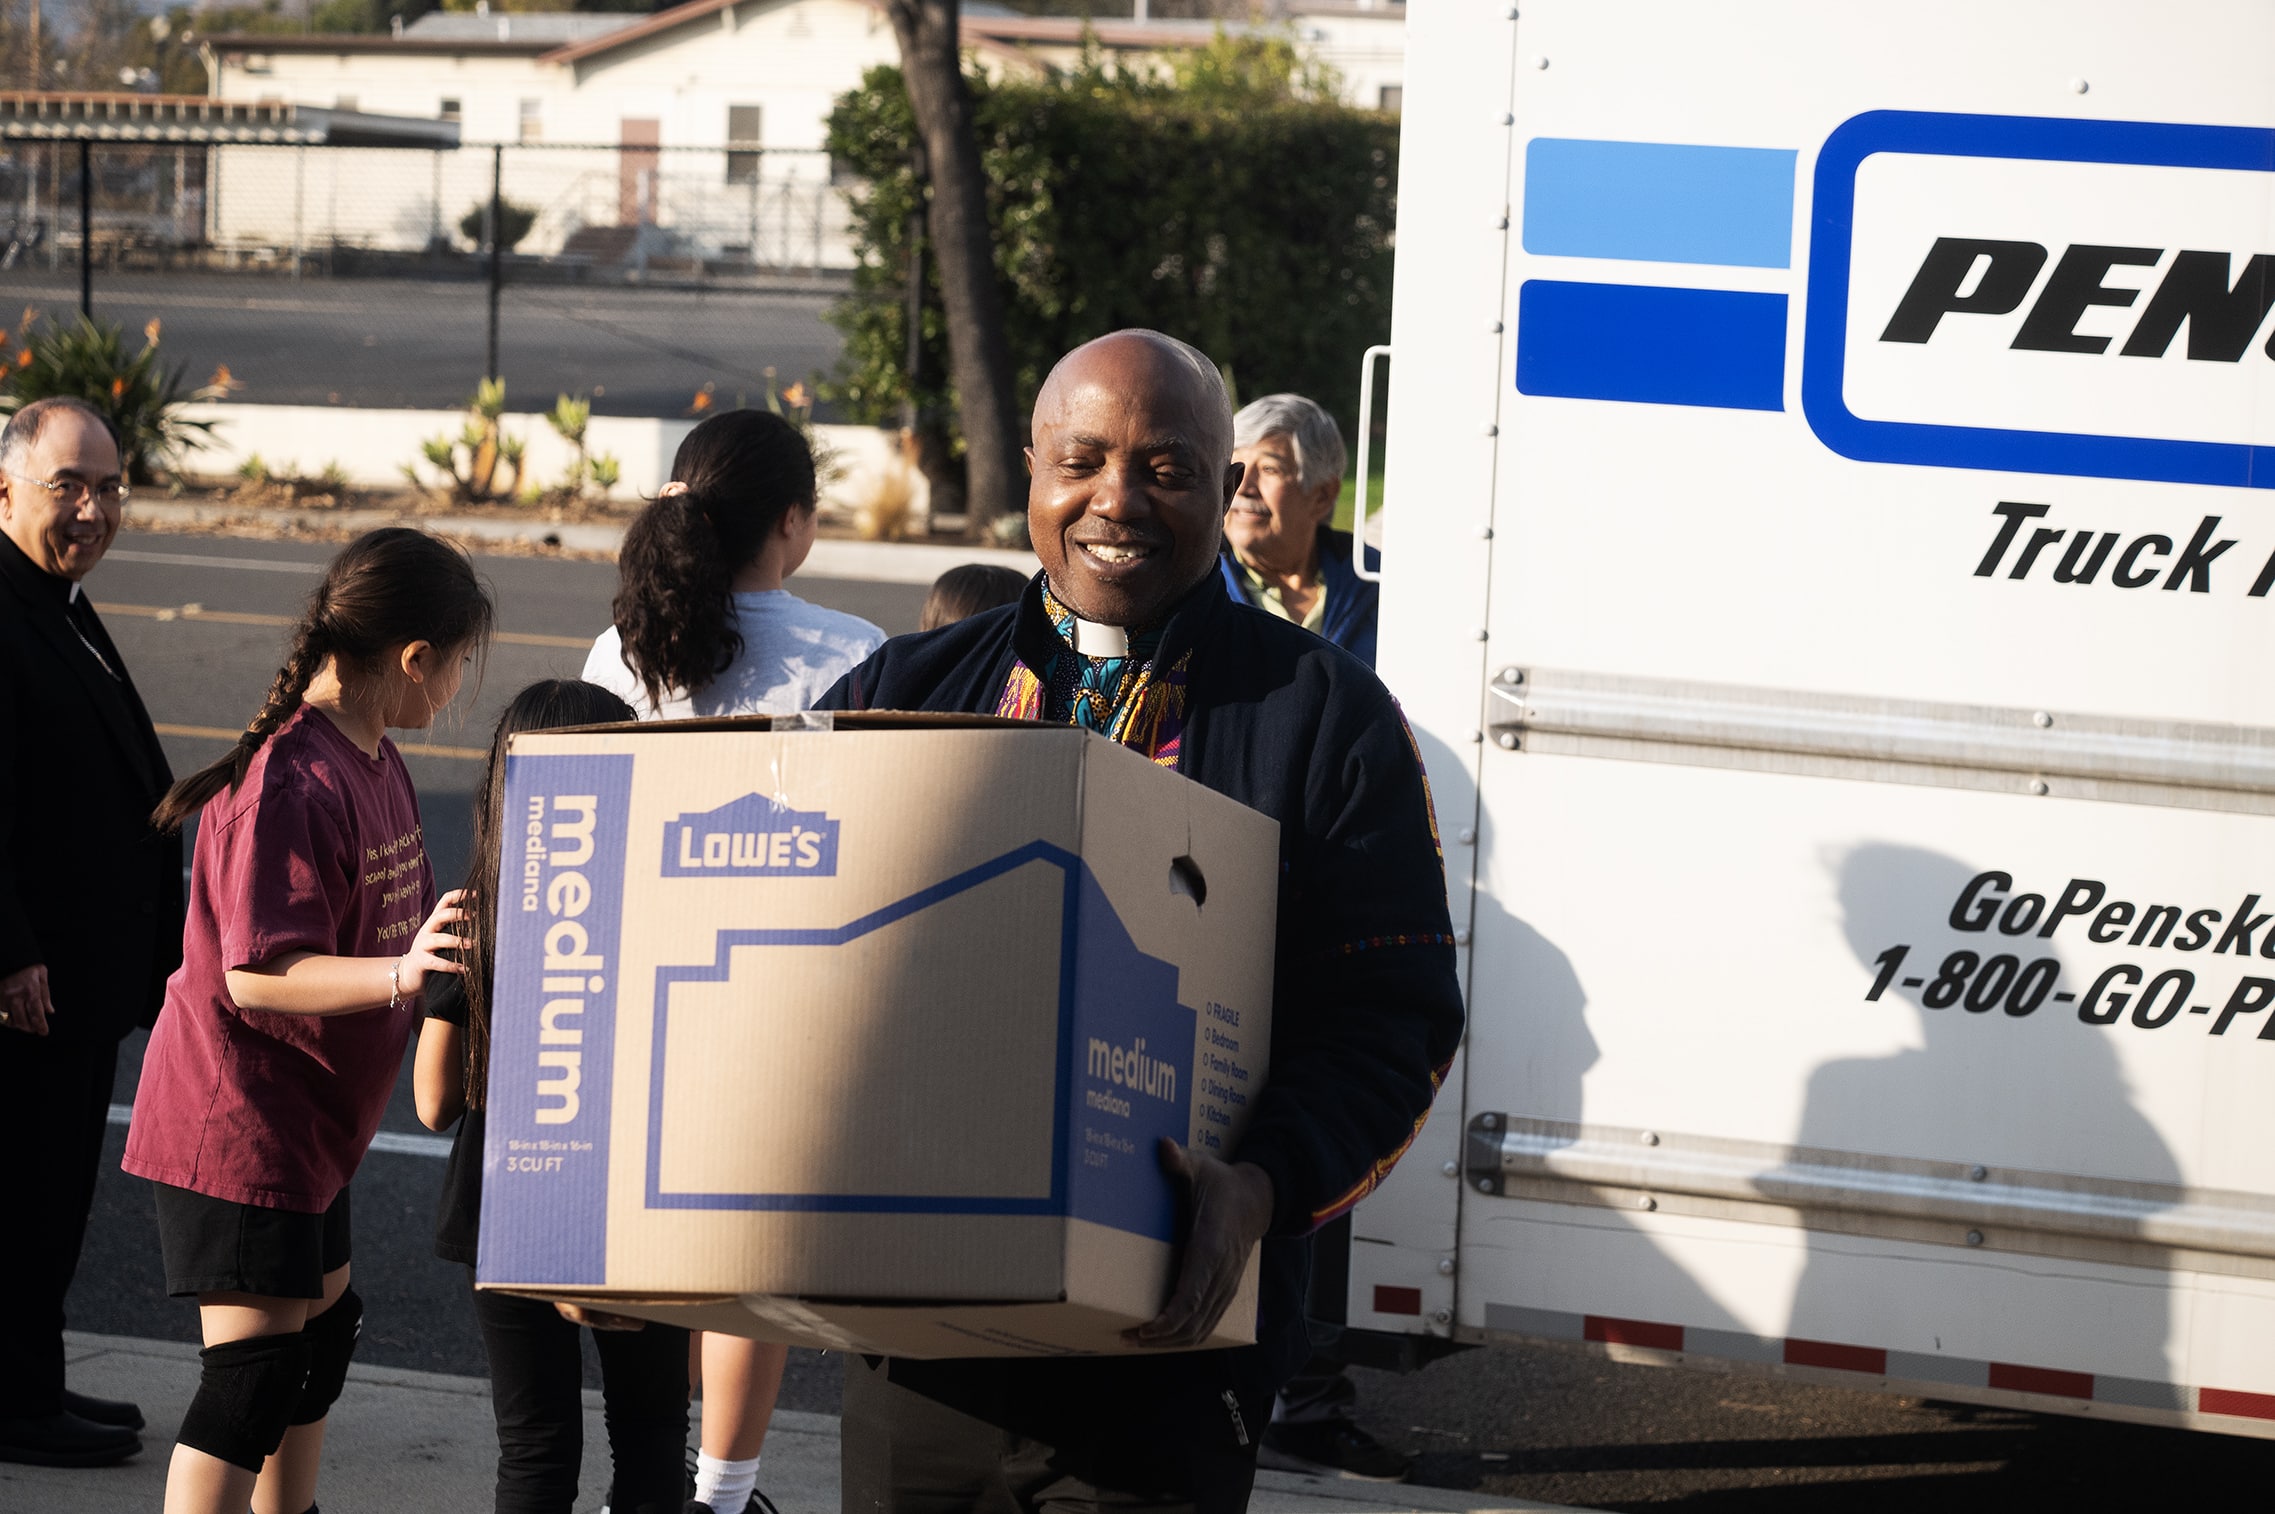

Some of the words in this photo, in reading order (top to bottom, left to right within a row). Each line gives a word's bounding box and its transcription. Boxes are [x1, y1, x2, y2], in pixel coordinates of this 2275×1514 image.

[1879, 237, 2275, 362] PEN
[1973, 501, 2239, 593] Truck
[522, 796, 546, 912] mediana
[679, 825, 822, 868] LOWE'S
[535, 795, 605, 1124] medium
[1212, 1003, 1240, 1028] FRAGILE
[1211, 1028, 1240, 1053] Bedroom
[1087, 1037, 1177, 1103] medium
[1210, 1053, 1230, 1079] Family
[1231, 1061, 1249, 1081] Room
[1086, 1089, 1130, 1118] mediana
[1206, 1104, 1232, 1127] Kitchen
[506, 1157, 518, 1172] 3
[519, 1157, 542, 1172] CU
[544, 1157, 565, 1172] FT
